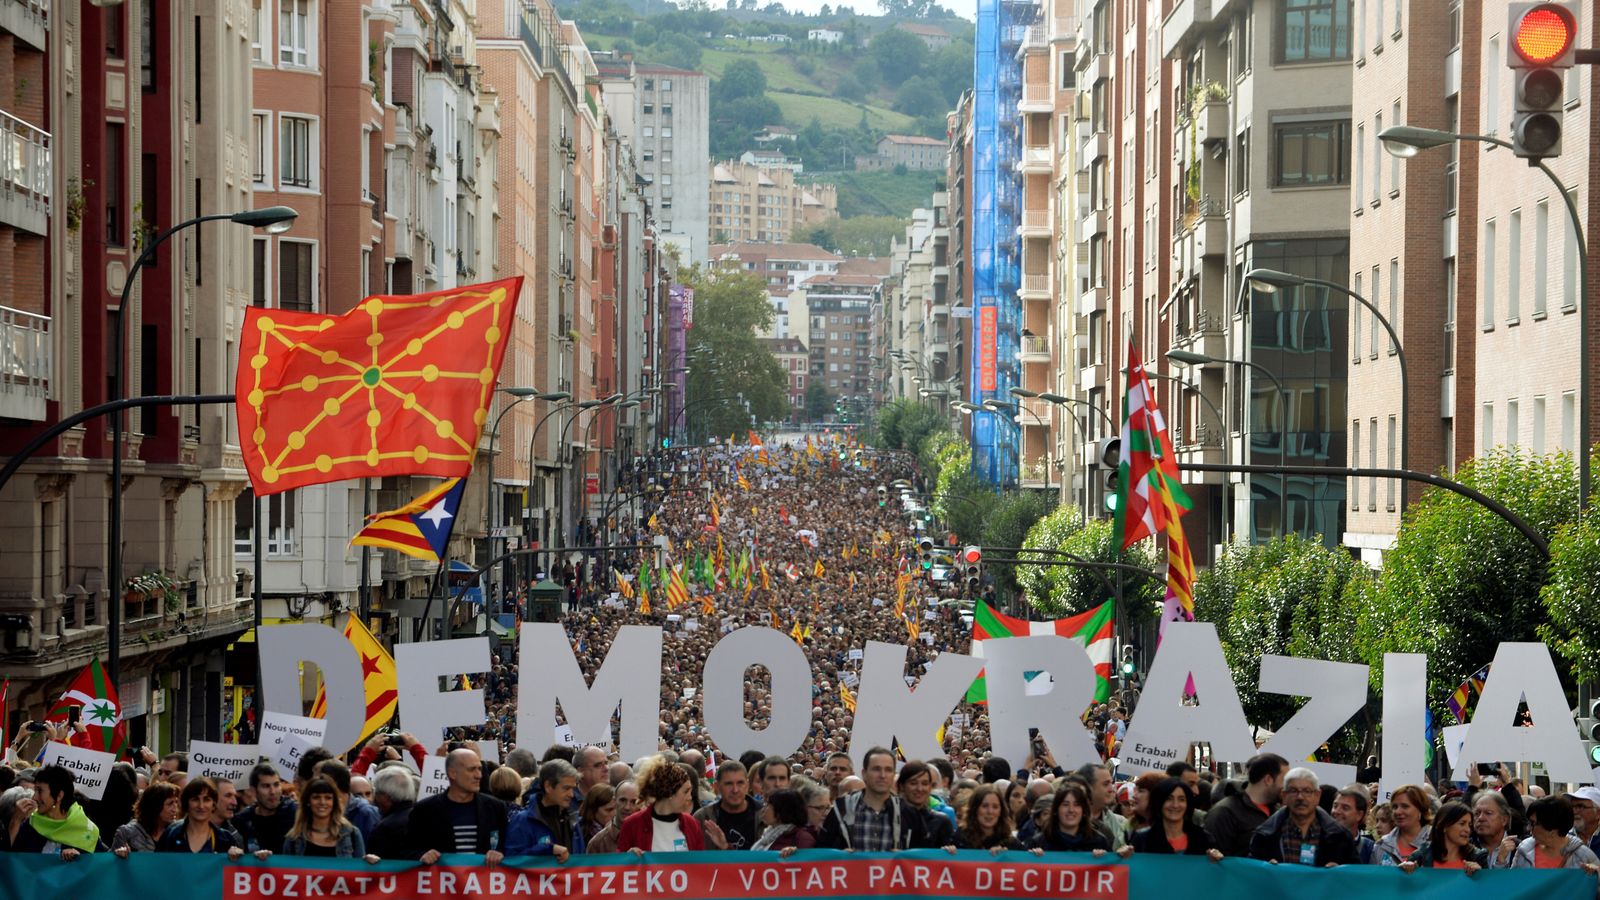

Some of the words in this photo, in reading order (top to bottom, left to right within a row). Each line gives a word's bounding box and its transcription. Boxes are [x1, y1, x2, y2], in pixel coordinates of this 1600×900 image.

[256, 621, 1596, 786] DEMOKRAZIA
[264, 722, 287, 733] Nous
[289, 725, 323, 738] voulons
[1135, 743, 1178, 759] Erabaki
[56, 755, 102, 774] Erabaki
[193, 752, 255, 767] Queremos
[1126, 756, 1151, 768] nahi
[75, 775, 102, 788] dugu
[233, 872, 397, 897] BOZKATU
[417, 869, 689, 896] ERABAKITZEKO
[738, 866, 848, 891] VOTAR
[868, 865, 955, 890] PARA
[975, 867, 1115, 893] DECIDIR
